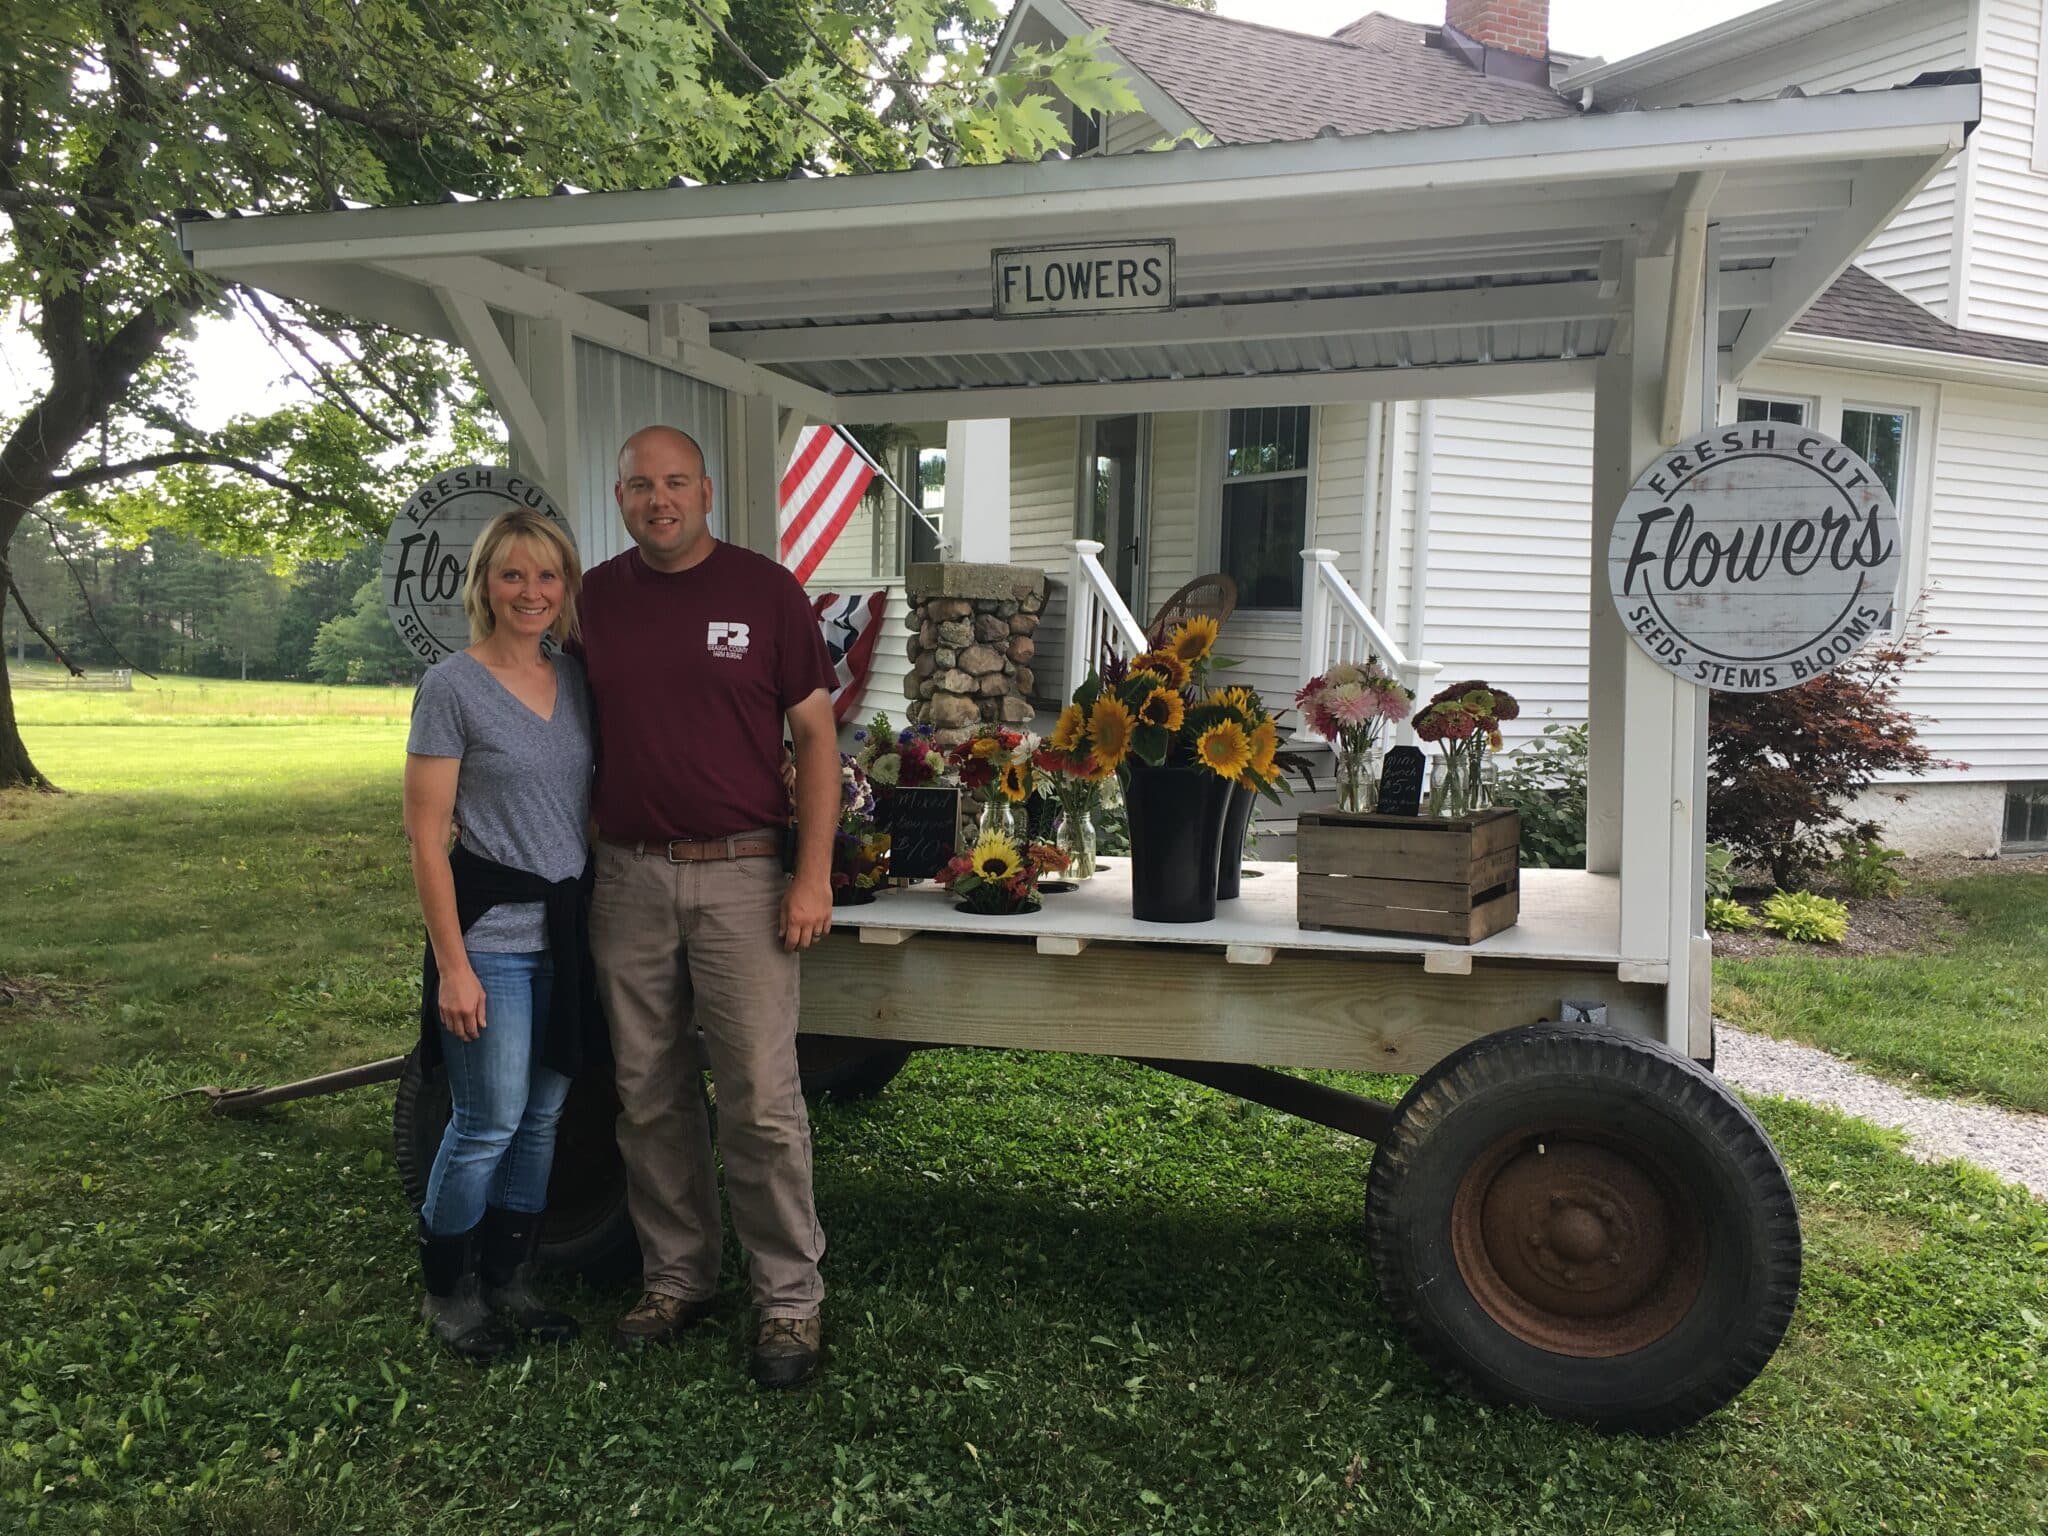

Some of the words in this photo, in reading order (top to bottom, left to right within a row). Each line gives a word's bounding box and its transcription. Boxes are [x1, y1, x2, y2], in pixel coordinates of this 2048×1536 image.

[1004, 257, 1162, 303] FLOWERS
[1648, 429, 1775, 496] FRESH
[1797, 438, 1869, 493] CUT
[406, 470, 491, 524] FRESH
[507, 478, 558, 519] CUT
[1623, 503, 1894, 597] Flowers
[398, 614, 441, 665] SEEDS
[1628, 605, 1688, 667] SEEDS
[1694, 660, 1778, 688] STEMS
[1789, 605, 1879, 680] BLOOMS
